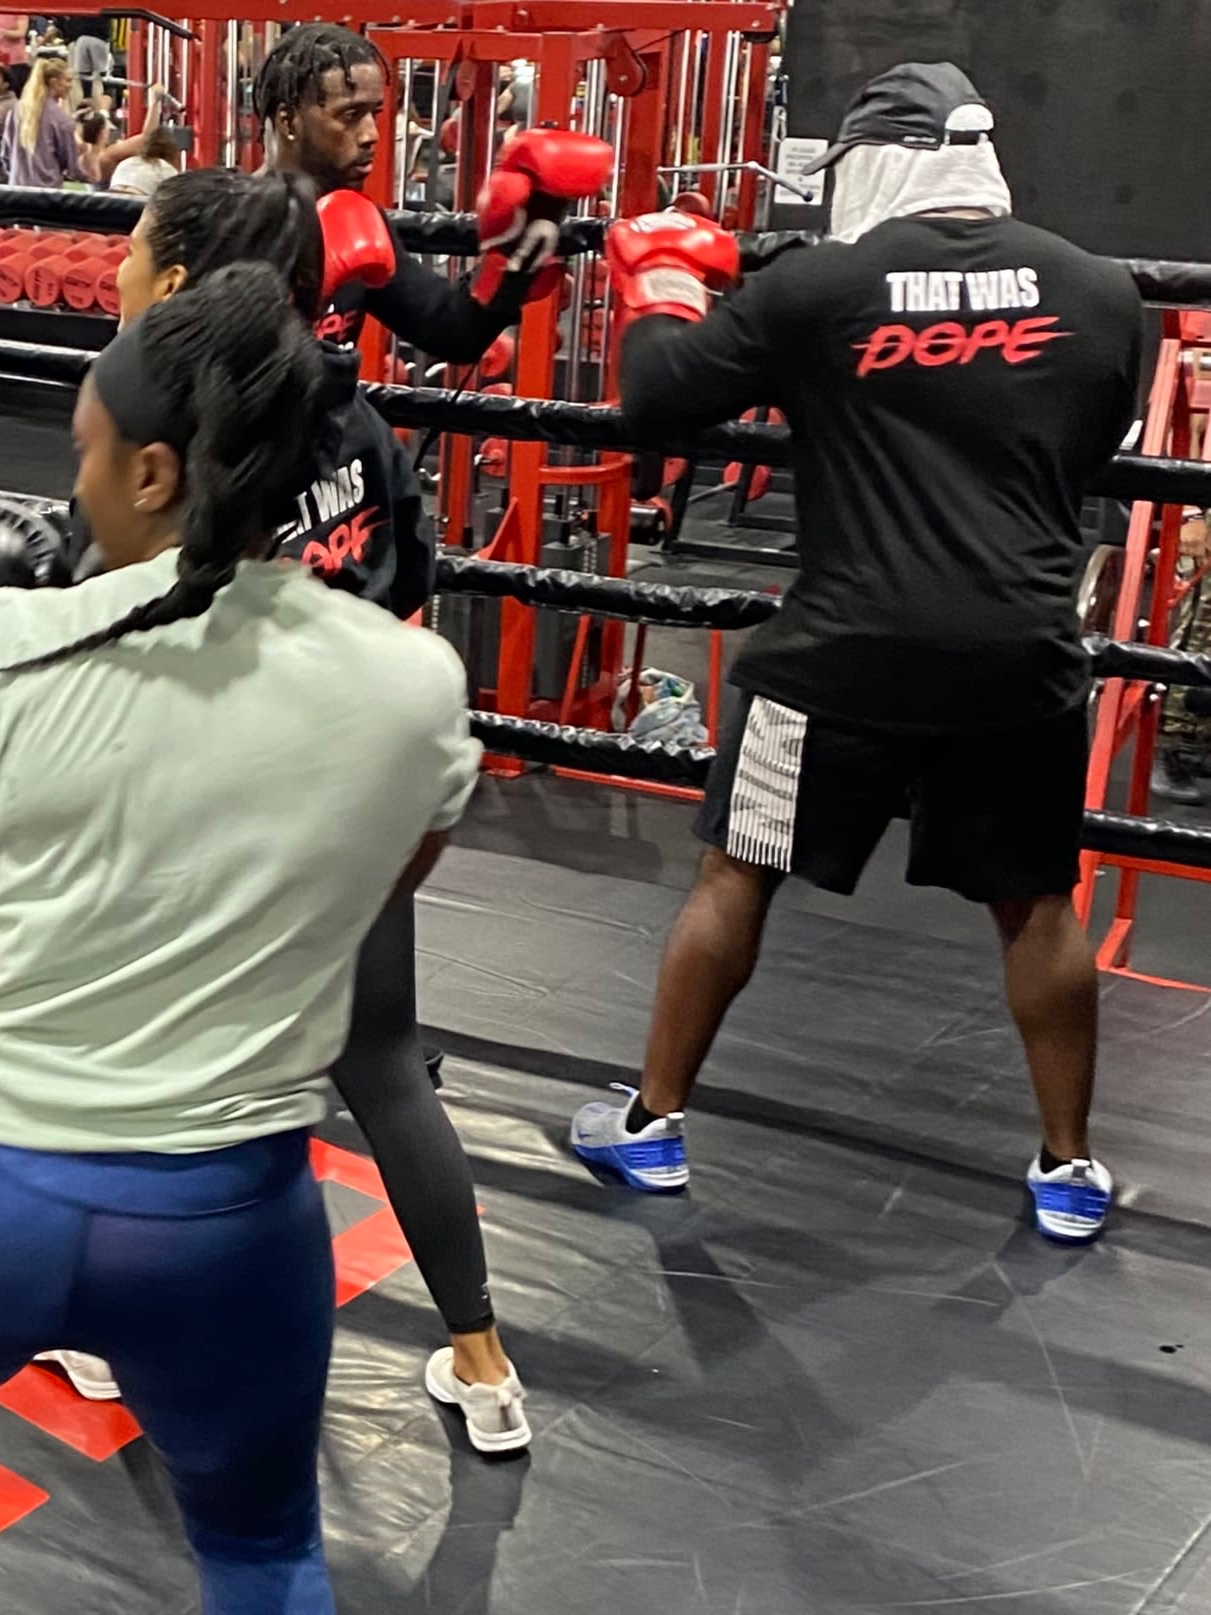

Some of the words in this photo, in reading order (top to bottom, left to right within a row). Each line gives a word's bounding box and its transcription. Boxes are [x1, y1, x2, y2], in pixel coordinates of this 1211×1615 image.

[886, 270, 964, 312] THAT
[964, 266, 1040, 311] WAS
[850, 316, 1075, 379] DOPE
[310, 458, 365, 523] WAS
